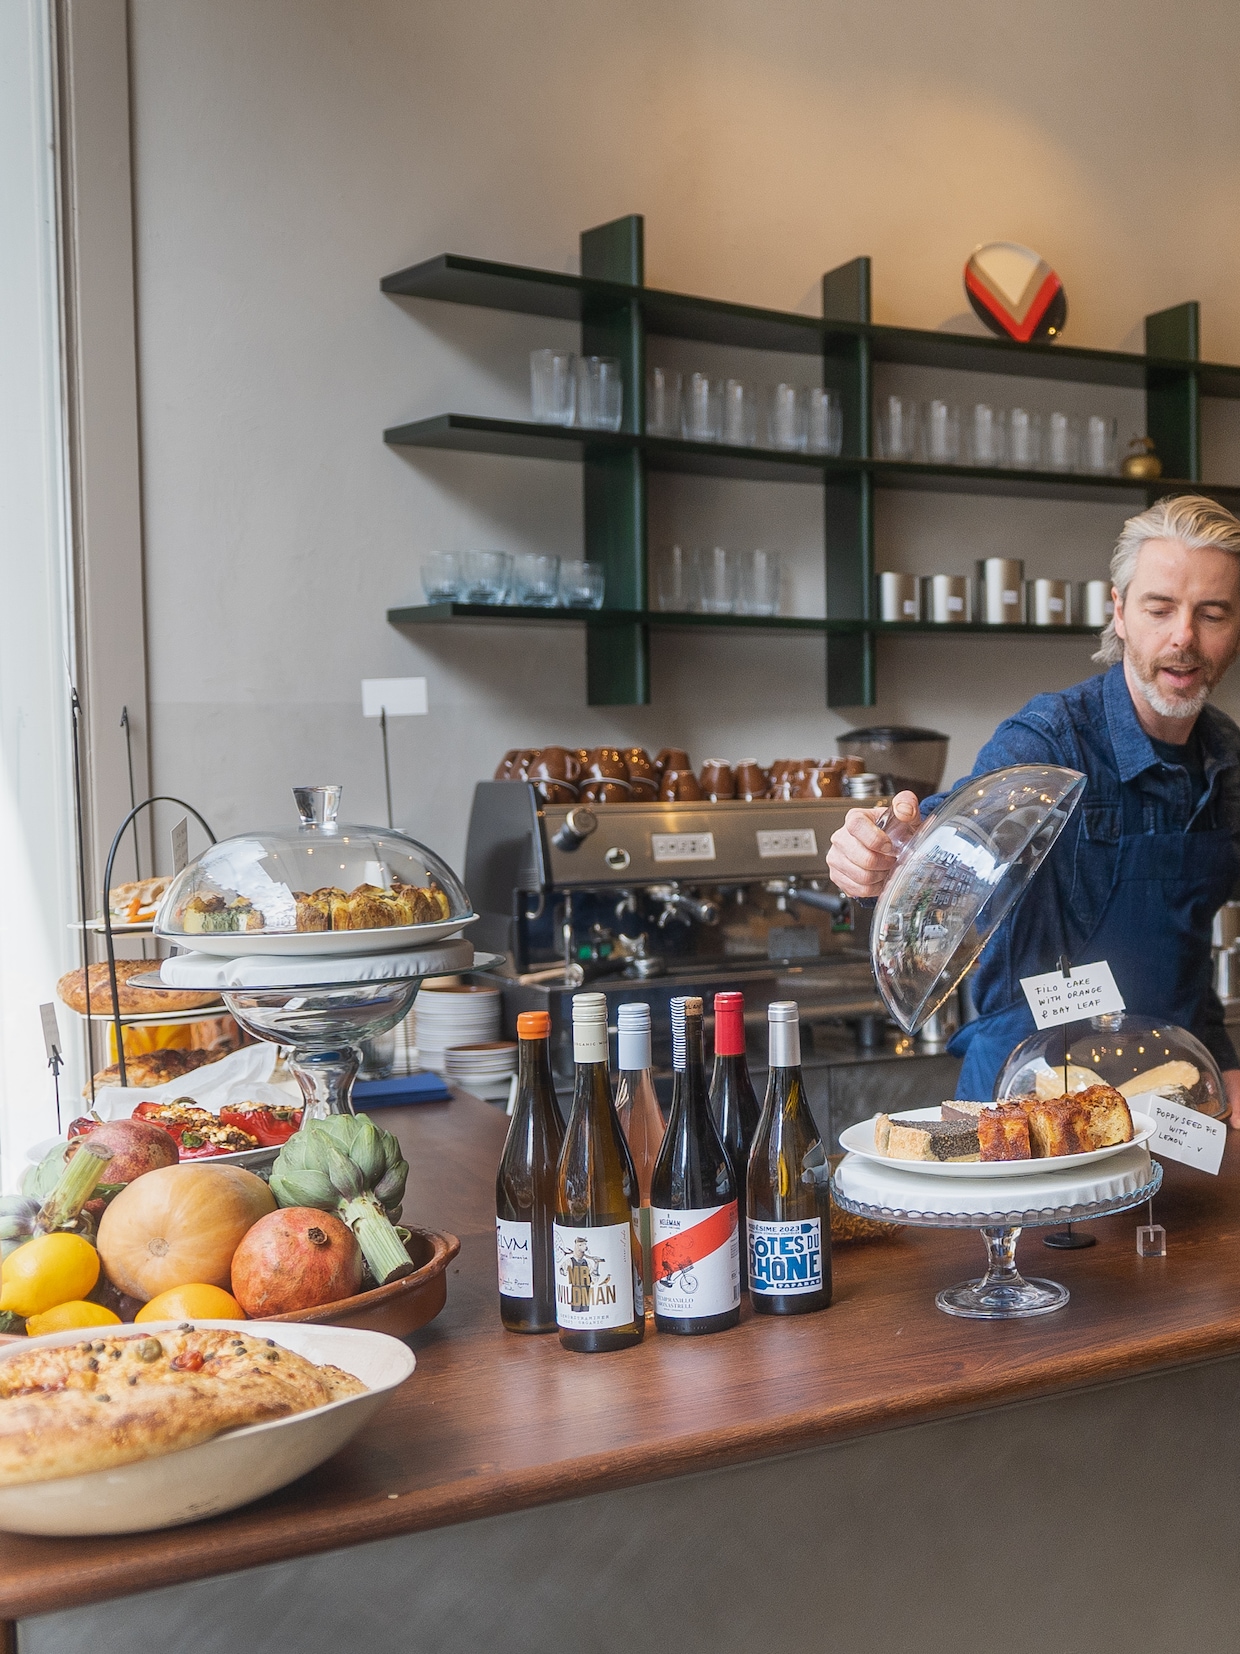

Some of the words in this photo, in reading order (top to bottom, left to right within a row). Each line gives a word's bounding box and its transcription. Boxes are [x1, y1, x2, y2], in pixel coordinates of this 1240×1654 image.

[1066, 978, 1091, 989] CAKE
[1067, 986, 1103, 999] ORANGE
[1052, 1006, 1070, 1016] BAY
[1077, 999, 1102, 1010] LEAF
[1156, 1107, 1180, 1122] POPPY
[1181, 1117, 1203, 1129] SEED
[749, 1233, 805, 1257] CÔTES
[807, 1233, 820, 1250] DU
[749, 1249, 821, 1283] RHÔNE
[557, 1284, 617, 1307] WILDMAN
